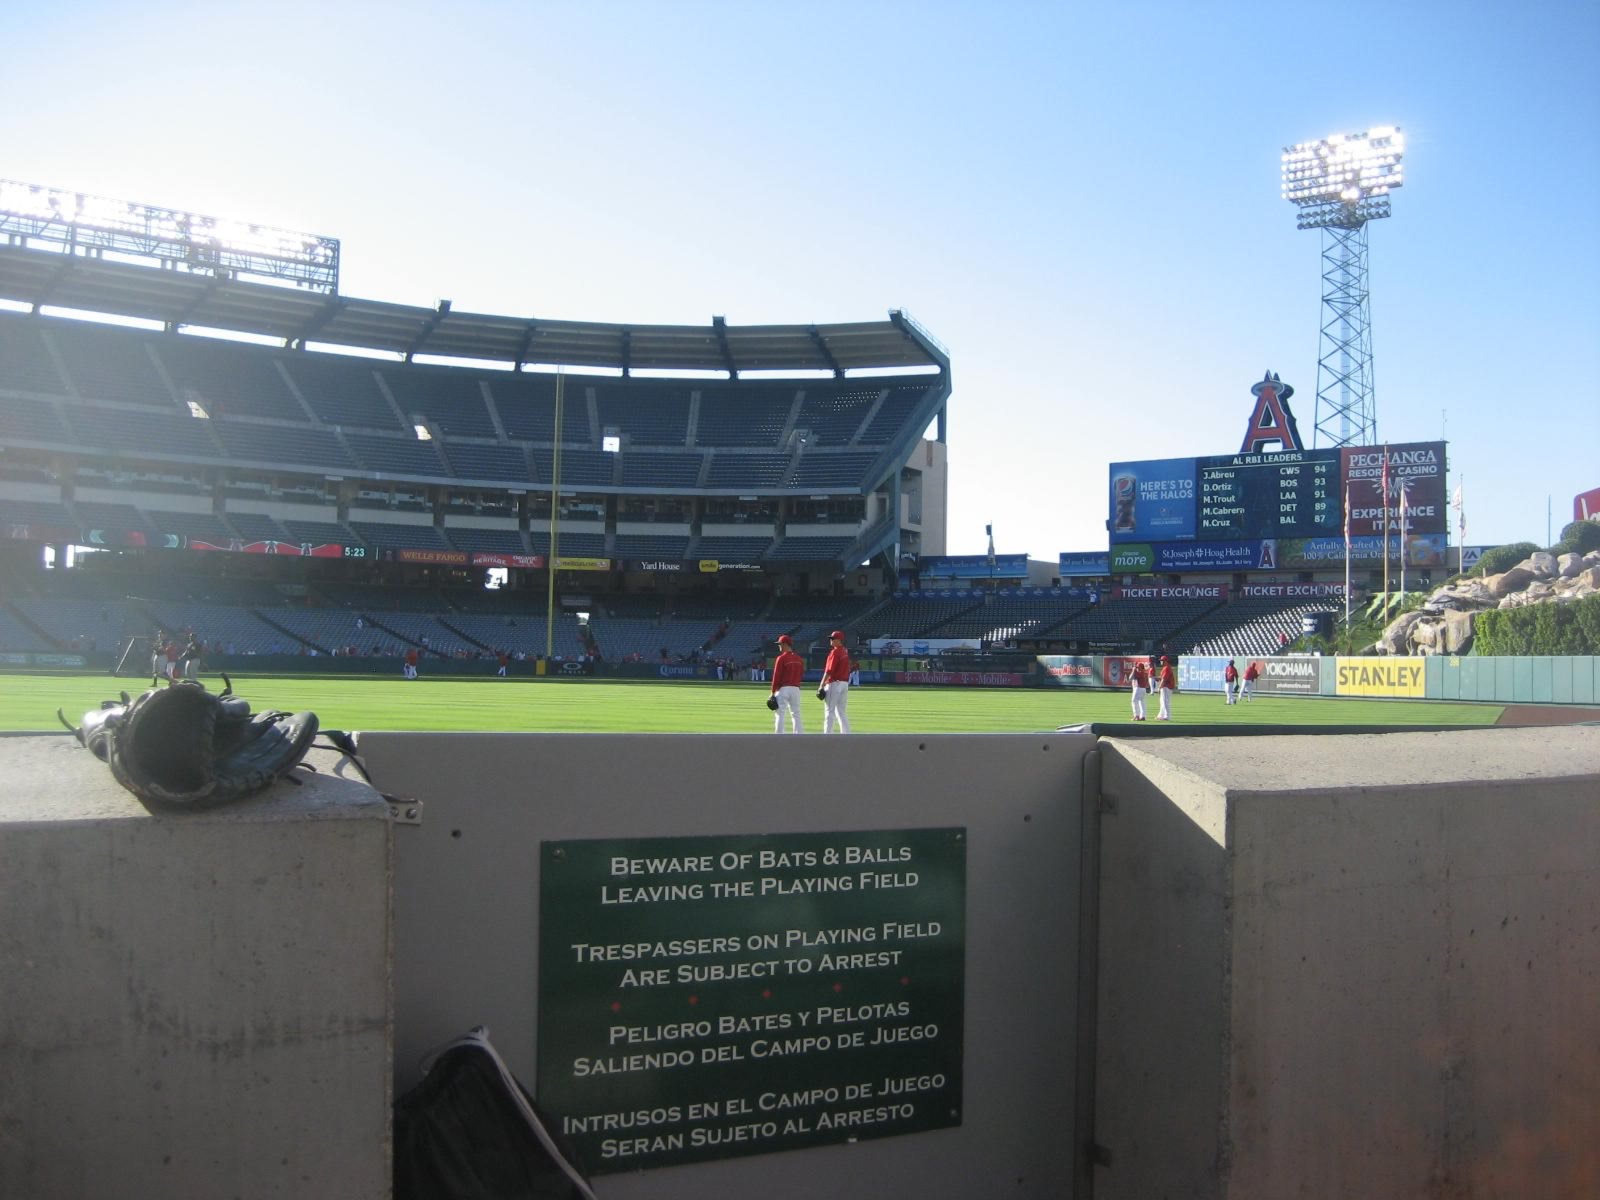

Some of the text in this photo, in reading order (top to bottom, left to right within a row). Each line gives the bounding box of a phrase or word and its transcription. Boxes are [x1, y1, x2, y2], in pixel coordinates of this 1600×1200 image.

[1232, 453, 1303, 465] AL RBI LEADERS
[1280, 467, 1300, 475] CWS
[1314, 465, 1326, 473] 94
[1349, 465, 1437, 477] RESOR CASINO
[1140, 479, 1193, 491] HERE'S TO
[1280, 479, 1298, 487] BOS
[1314, 478, 1326, 486] 93
[1140, 490, 1193, 500] THE HALOS
[1280, 491, 1297, 500] LAA
[1314, 490, 1326, 498] 91
[1280, 503, 1298, 512] DET
[1314, 502, 1326, 510] 89
[1280, 515, 1297, 524] BAL
[1314, 514, 1326, 523] 87
[1310, 539, 1397, 551] Artfully Cafted Wth
[344, 547, 365, 557] 5:23
[402, 551, 466, 562] WELLS FARGO
[1204, 548, 1225, 559] Hoag
[1225, 546, 1251, 557] Health
[1328, 551, 1368, 560] Calirnia
[641, 561, 680, 570] Yard House
[1114, 556, 1147, 566] more
[1121, 586, 1219, 598] TICKET EXCHANGE
[1243, 586, 1284, 596] TICKET
[1265, 662, 1315, 676] YOKOHAMA
[1338, 666, 1421, 687] STANLEY
[611, 846, 912, 876] BEWARE OF BATS & BALLS
[601, 871, 919, 905] LEAVING THE PLAYING FIELD
[571, 921, 941, 963] TRESPASSERS ON PLAYING FIELD
[619, 950, 903, 988] ARE SUBJECT TO ARREST
[609, 1001, 910, 1045] PELIGRO BATES Y PELOTAS
[573, 1023, 939, 1077] SALIENDO DEL CAMPO DE JUEGO
[563, 1073, 946, 1135] INTRUSOS EN EL CAMPO DE JUEGO
[601, 1103, 914, 1159] SERAN SUJETO AL ARRESTO
